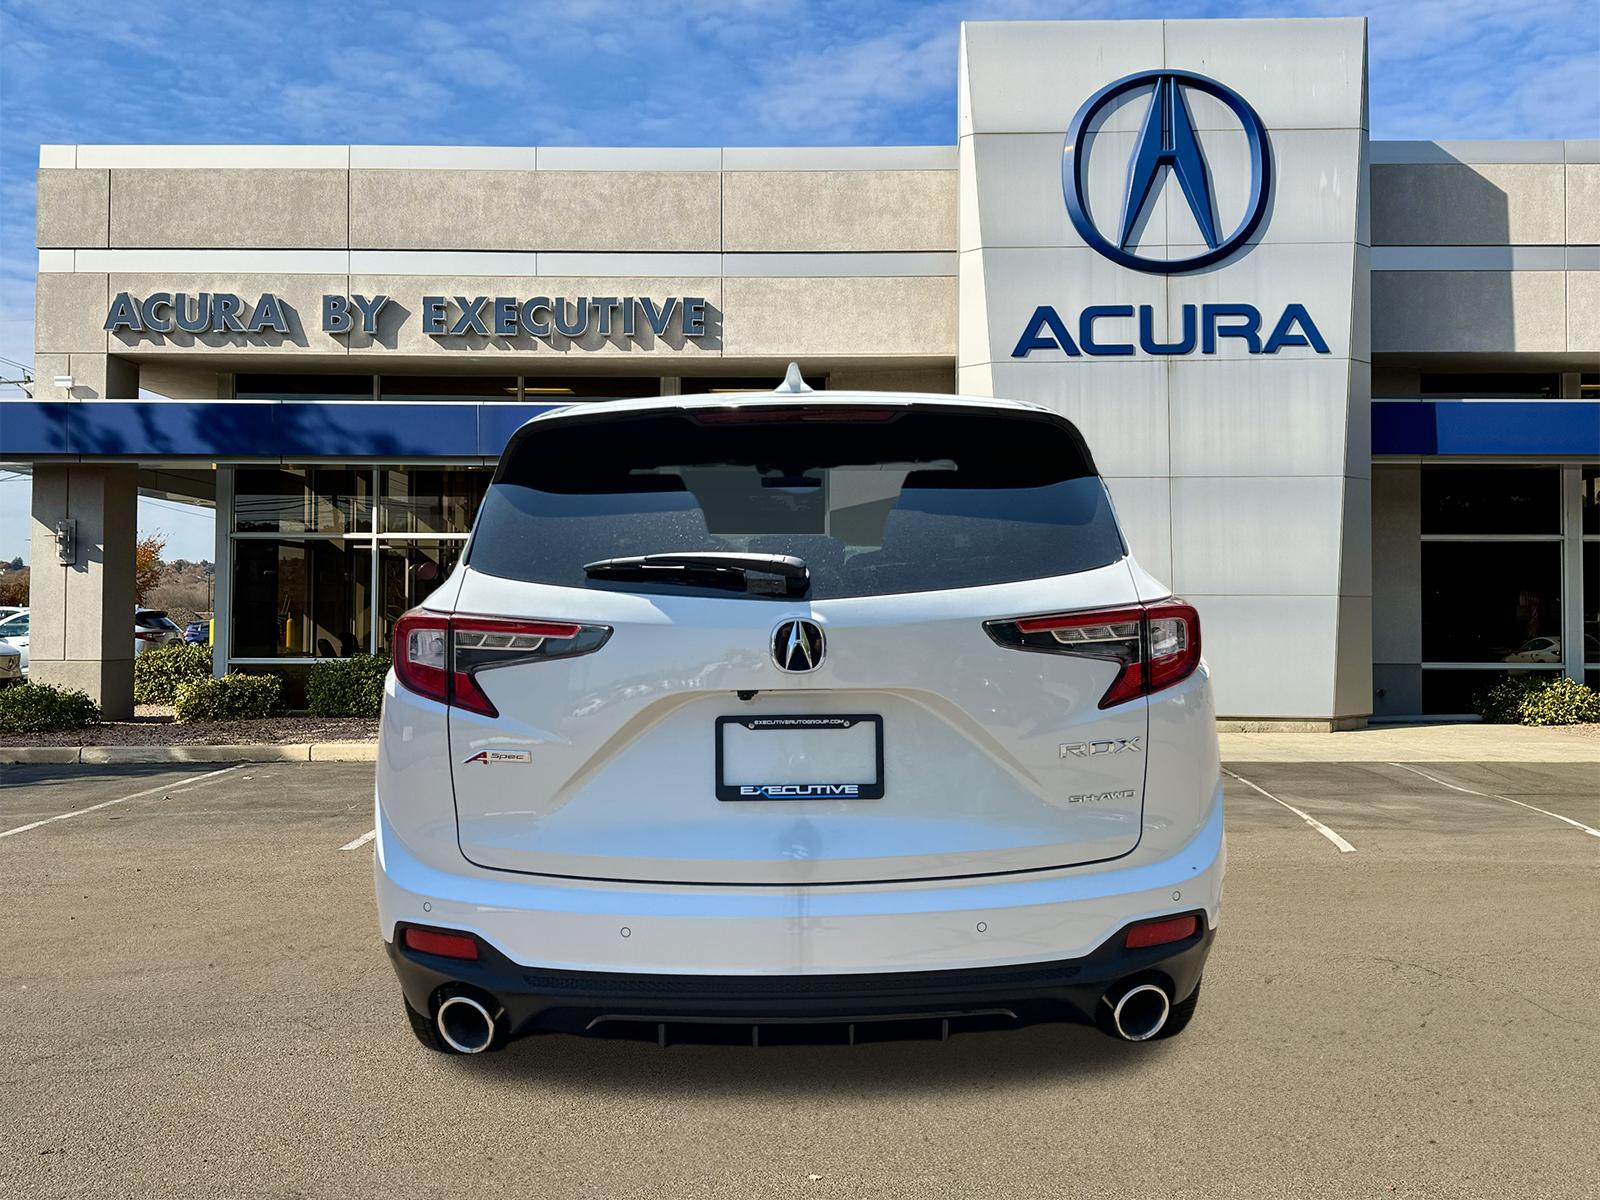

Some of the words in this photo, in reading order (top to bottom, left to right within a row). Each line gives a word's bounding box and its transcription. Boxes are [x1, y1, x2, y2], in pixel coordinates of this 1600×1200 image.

[103, 292, 290, 334] ACURA
[321, 294, 391, 335] BY
[422, 295, 706, 337] EXECUTIVE
[1011, 303, 1332, 357] ACURA
[1059, 736, 1142, 759] RDX
[740, 785, 859, 798] EXECUTIVE
